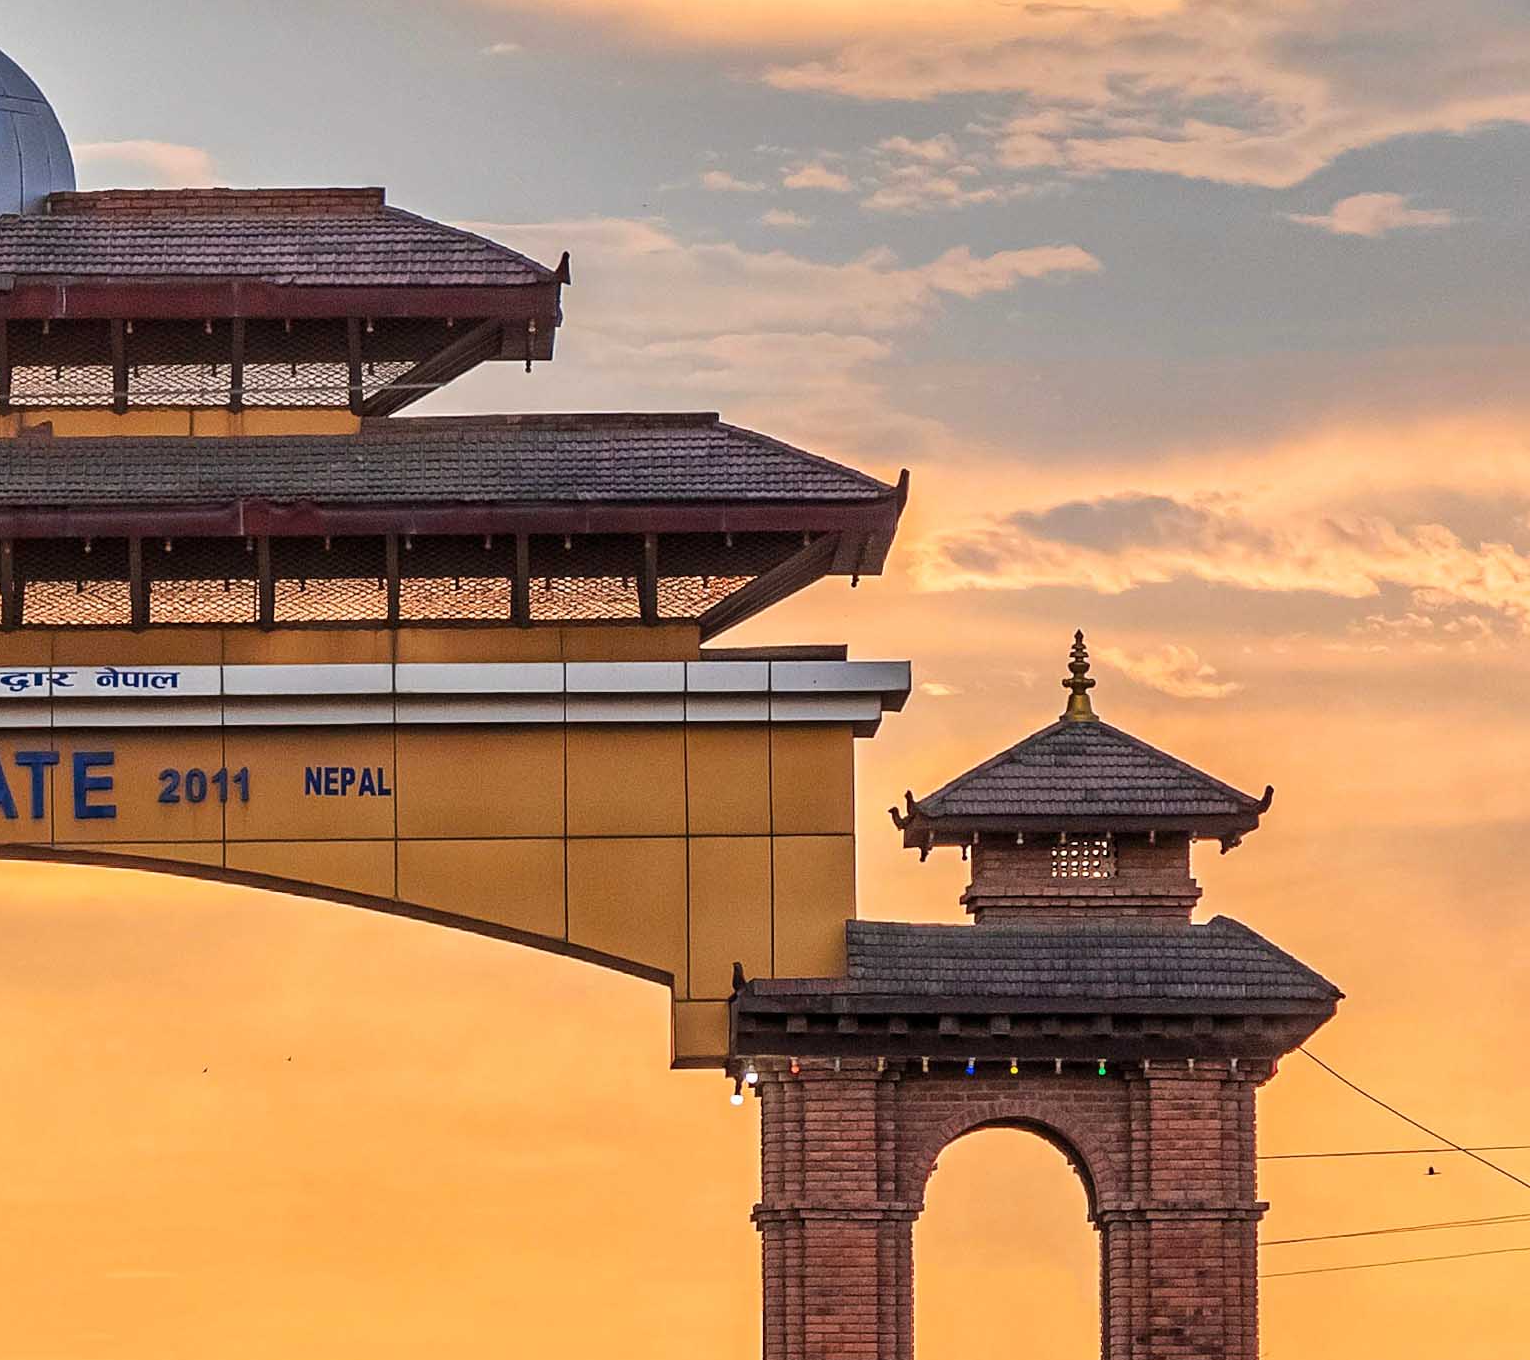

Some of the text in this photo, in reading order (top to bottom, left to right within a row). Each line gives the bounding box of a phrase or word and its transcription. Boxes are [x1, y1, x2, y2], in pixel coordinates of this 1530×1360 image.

[0, 671, 78, 693] द्वार
[95, 667, 181, 689] नेपाल
[157, 765, 392, 804] 2011 NEPAL
